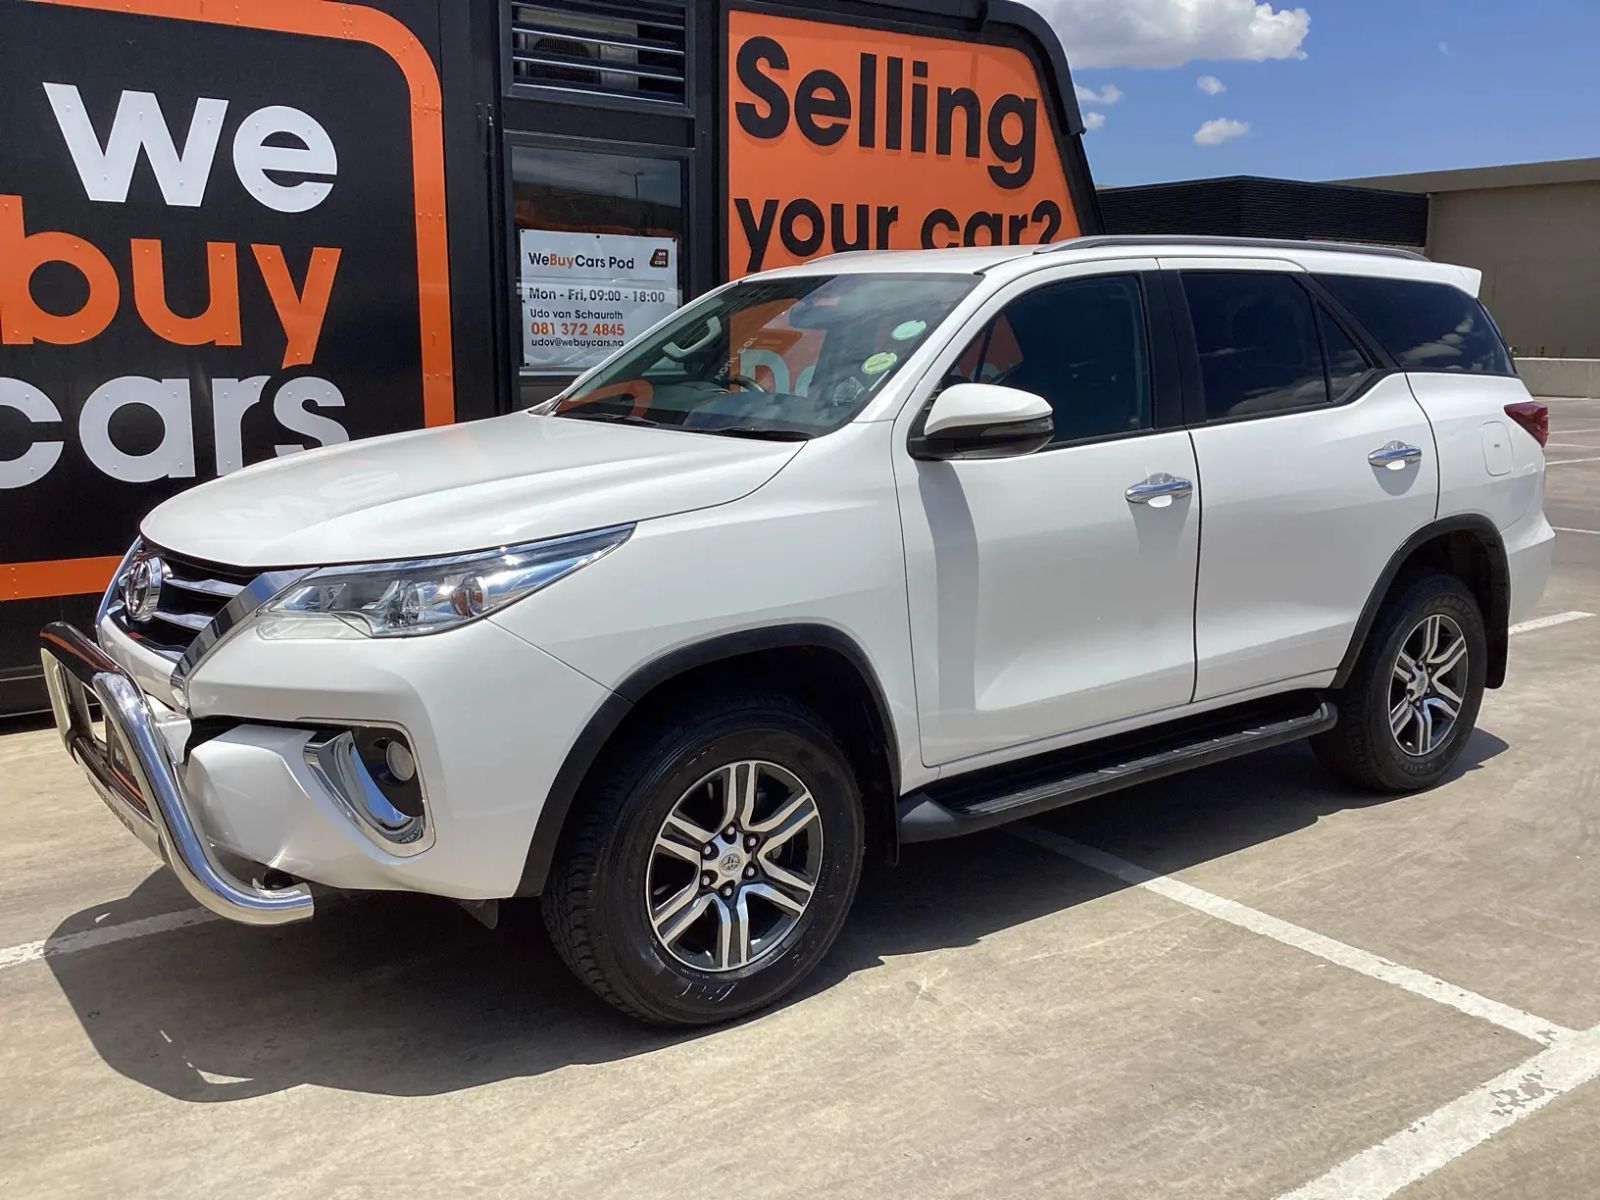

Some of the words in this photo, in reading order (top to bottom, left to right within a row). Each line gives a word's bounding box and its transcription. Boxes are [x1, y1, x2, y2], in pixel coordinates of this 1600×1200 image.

[735, 36, 1037, 189] Selling
[43, 82, 337, 212] we
[734, 198, 898, 271] your
[0, 195, 341, 369] buy
[528, 252, 606, 269] WeBuyCars
[609, 256, 634, 270] Pod
[529, 287, 556, 300] Mon
[568, 289, 587, 302] Fri,
[589, 289, 621, 302] 09:00
[633, 291, 665, 303] 18:00
[530, 308, 550, 319] Udo
[552, 310, 571, 319] van
[575, 309, 623, 320] Schauroth
[531, 322, 556, 335] 081
[561, 322, 588, 336] 372
[593, 323, 625, 336] 4845
[531, 337, 624, 349] udov@webuycars.na
[0, 376, 349, 489] cars
